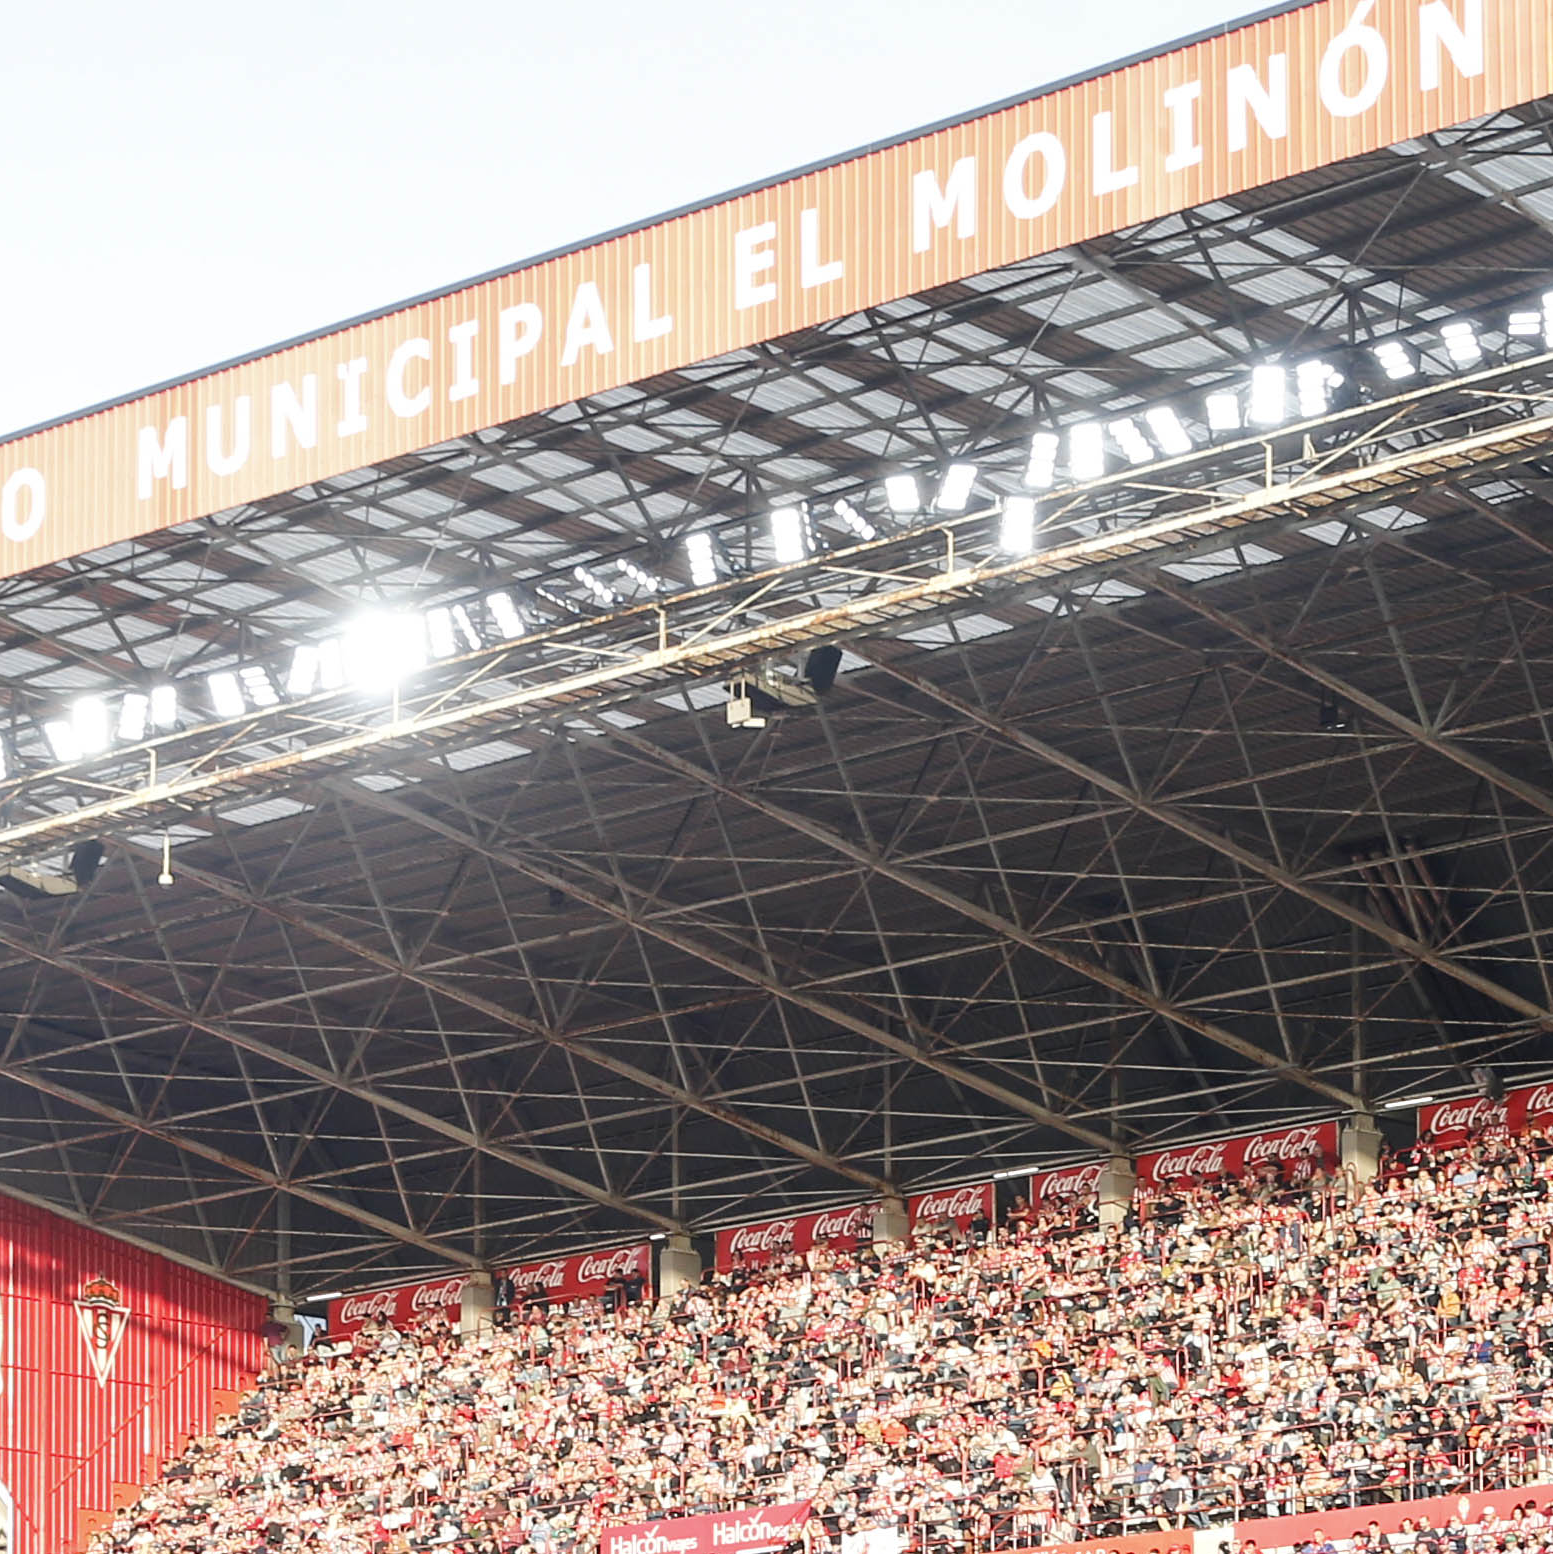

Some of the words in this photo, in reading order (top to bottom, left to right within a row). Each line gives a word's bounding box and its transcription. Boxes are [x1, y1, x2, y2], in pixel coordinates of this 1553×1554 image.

[137, 262, 675, 501] MUNICIPAL
[731, 206, 845, 315] EL
[911, 0, 1486, 254] MOLINÓN
[1152, 1142, 1227, 1182] Coca-Cola
[915, 1185, 986, 1221] Coca-Cola
